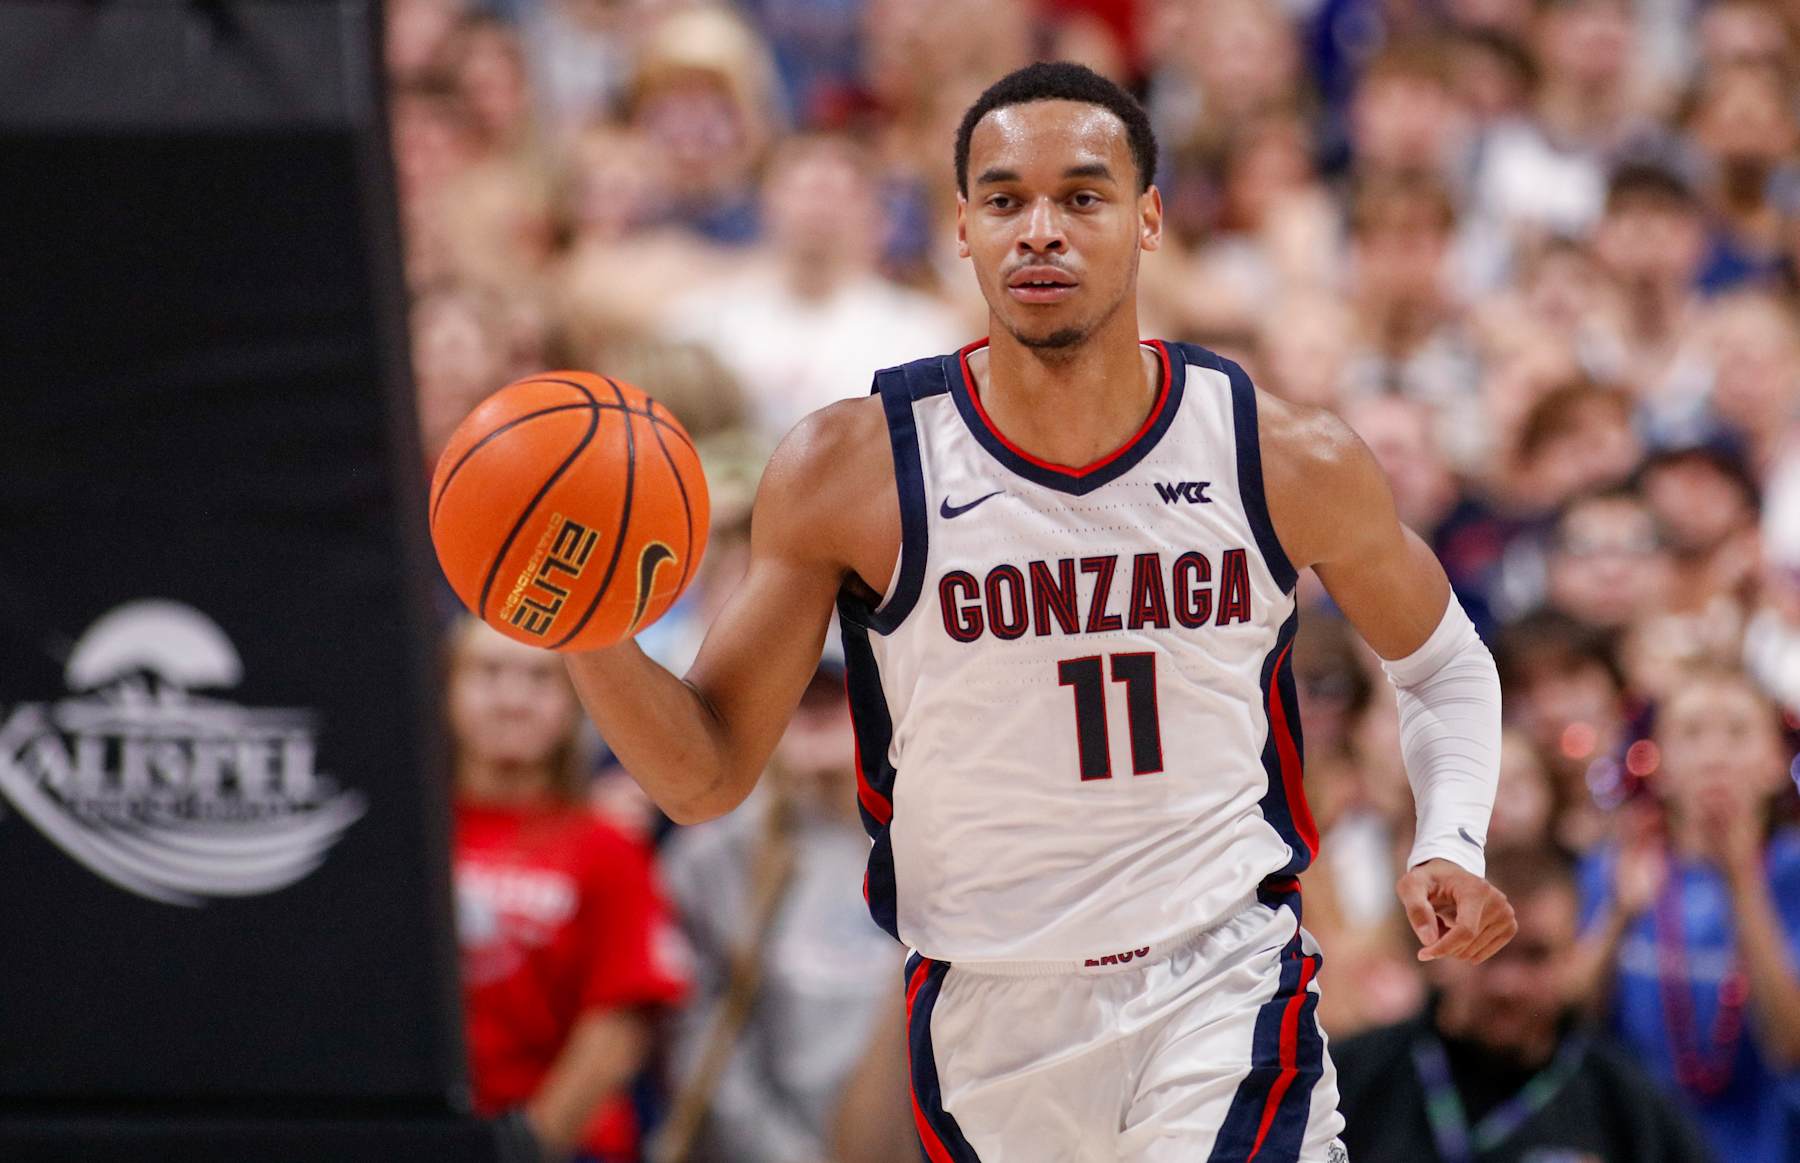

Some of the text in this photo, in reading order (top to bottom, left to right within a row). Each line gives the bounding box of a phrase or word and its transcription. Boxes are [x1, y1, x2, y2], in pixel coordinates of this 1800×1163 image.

[1153, 481, 1213, 505] WCC
[508, 516, 601, 638] ELITE
[938, 548, 1251, 643] GONZAGA
[1057, 651, 1164, 782] 11
